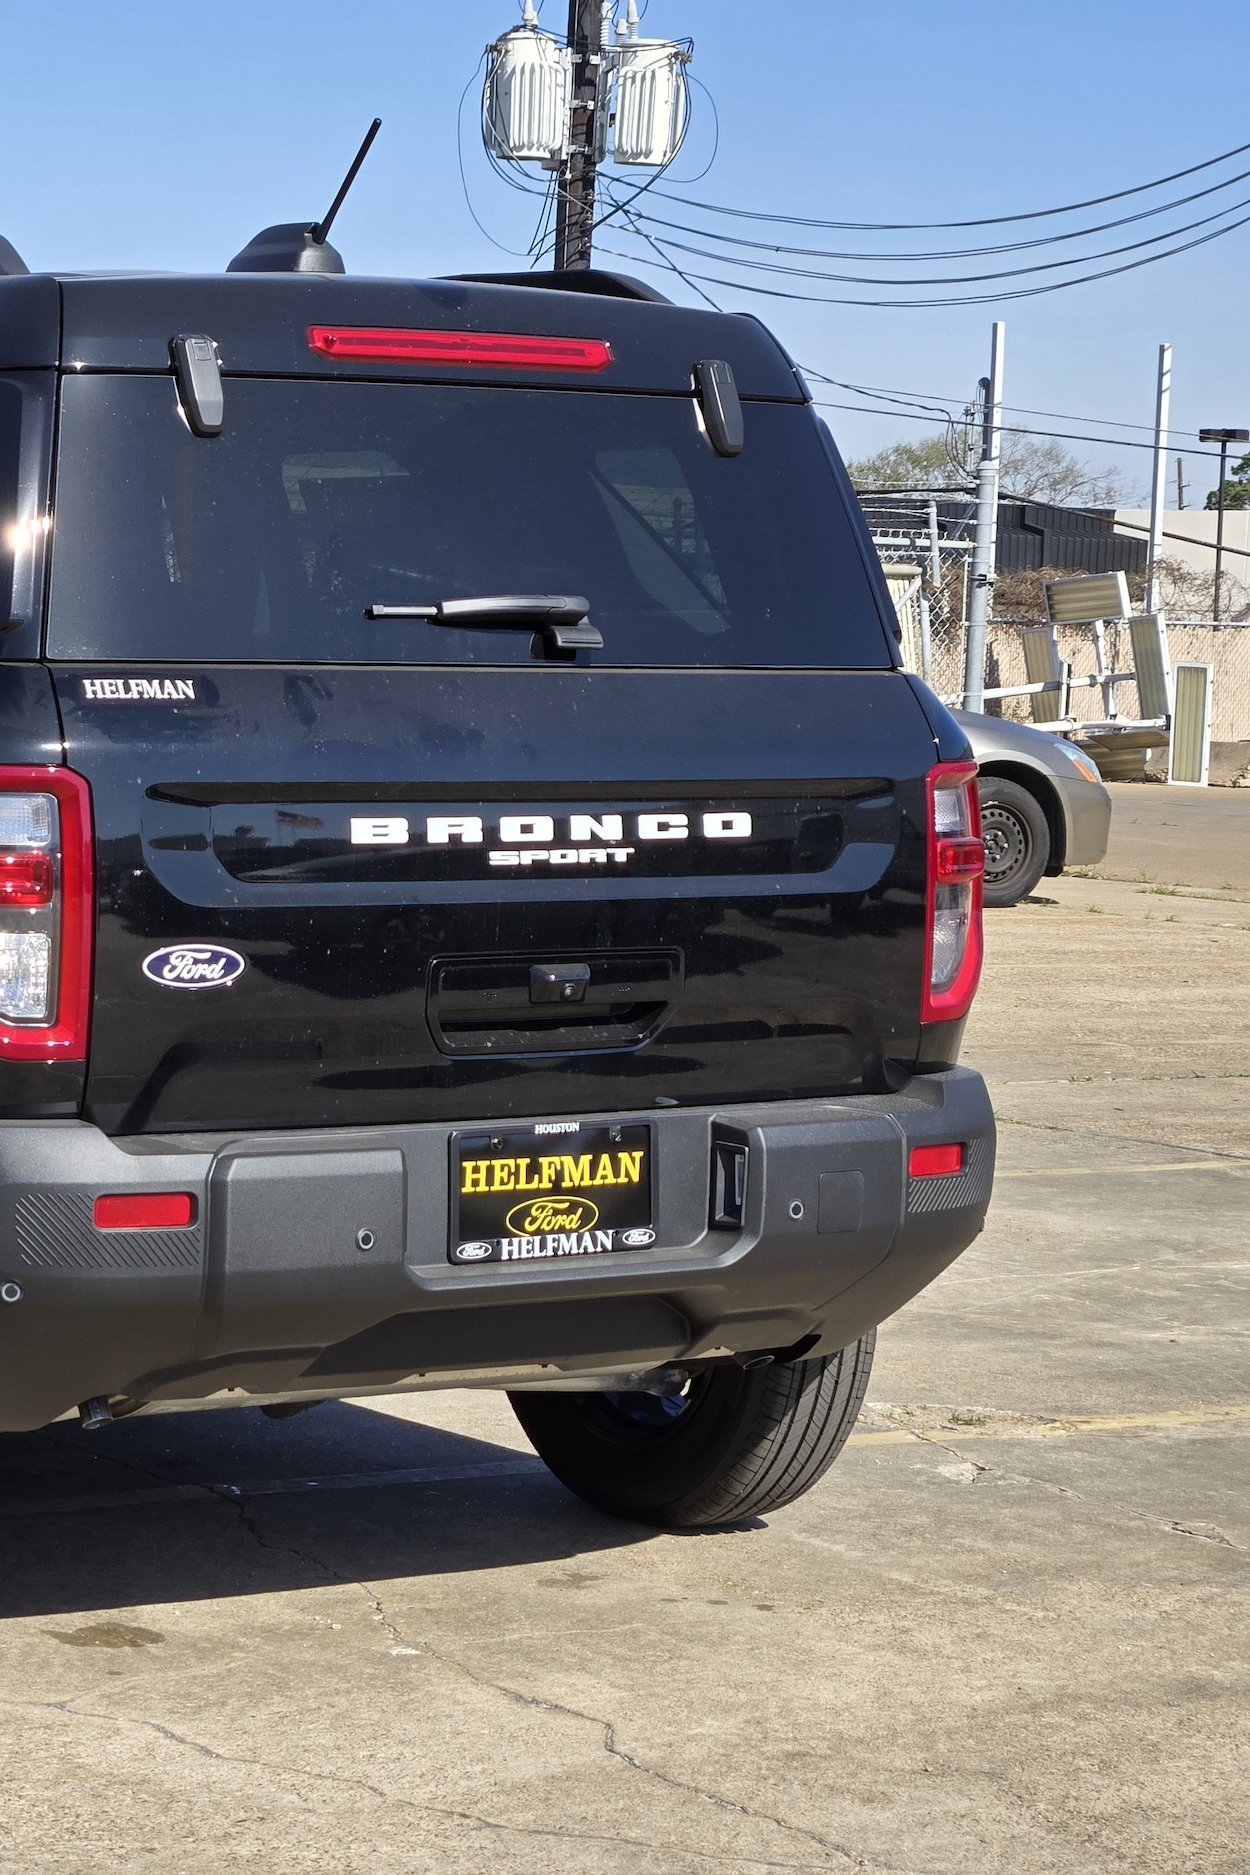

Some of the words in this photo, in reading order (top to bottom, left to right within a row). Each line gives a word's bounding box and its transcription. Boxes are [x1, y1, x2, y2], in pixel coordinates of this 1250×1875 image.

[82, 678, 197, 701] HELFMAN
[350, 811, 753, 846] BRONCO
[488, 847, 636, 867] SPORT
[162, 947, 229, 982] Ford
[534, 1122, 580, 1135] HOUSTON
[461, 1150, 645, 1193] HELFMAN
[523, 1201, 584, 1232] Ford
[500, 1229, 615, 1260] HELFMAN
